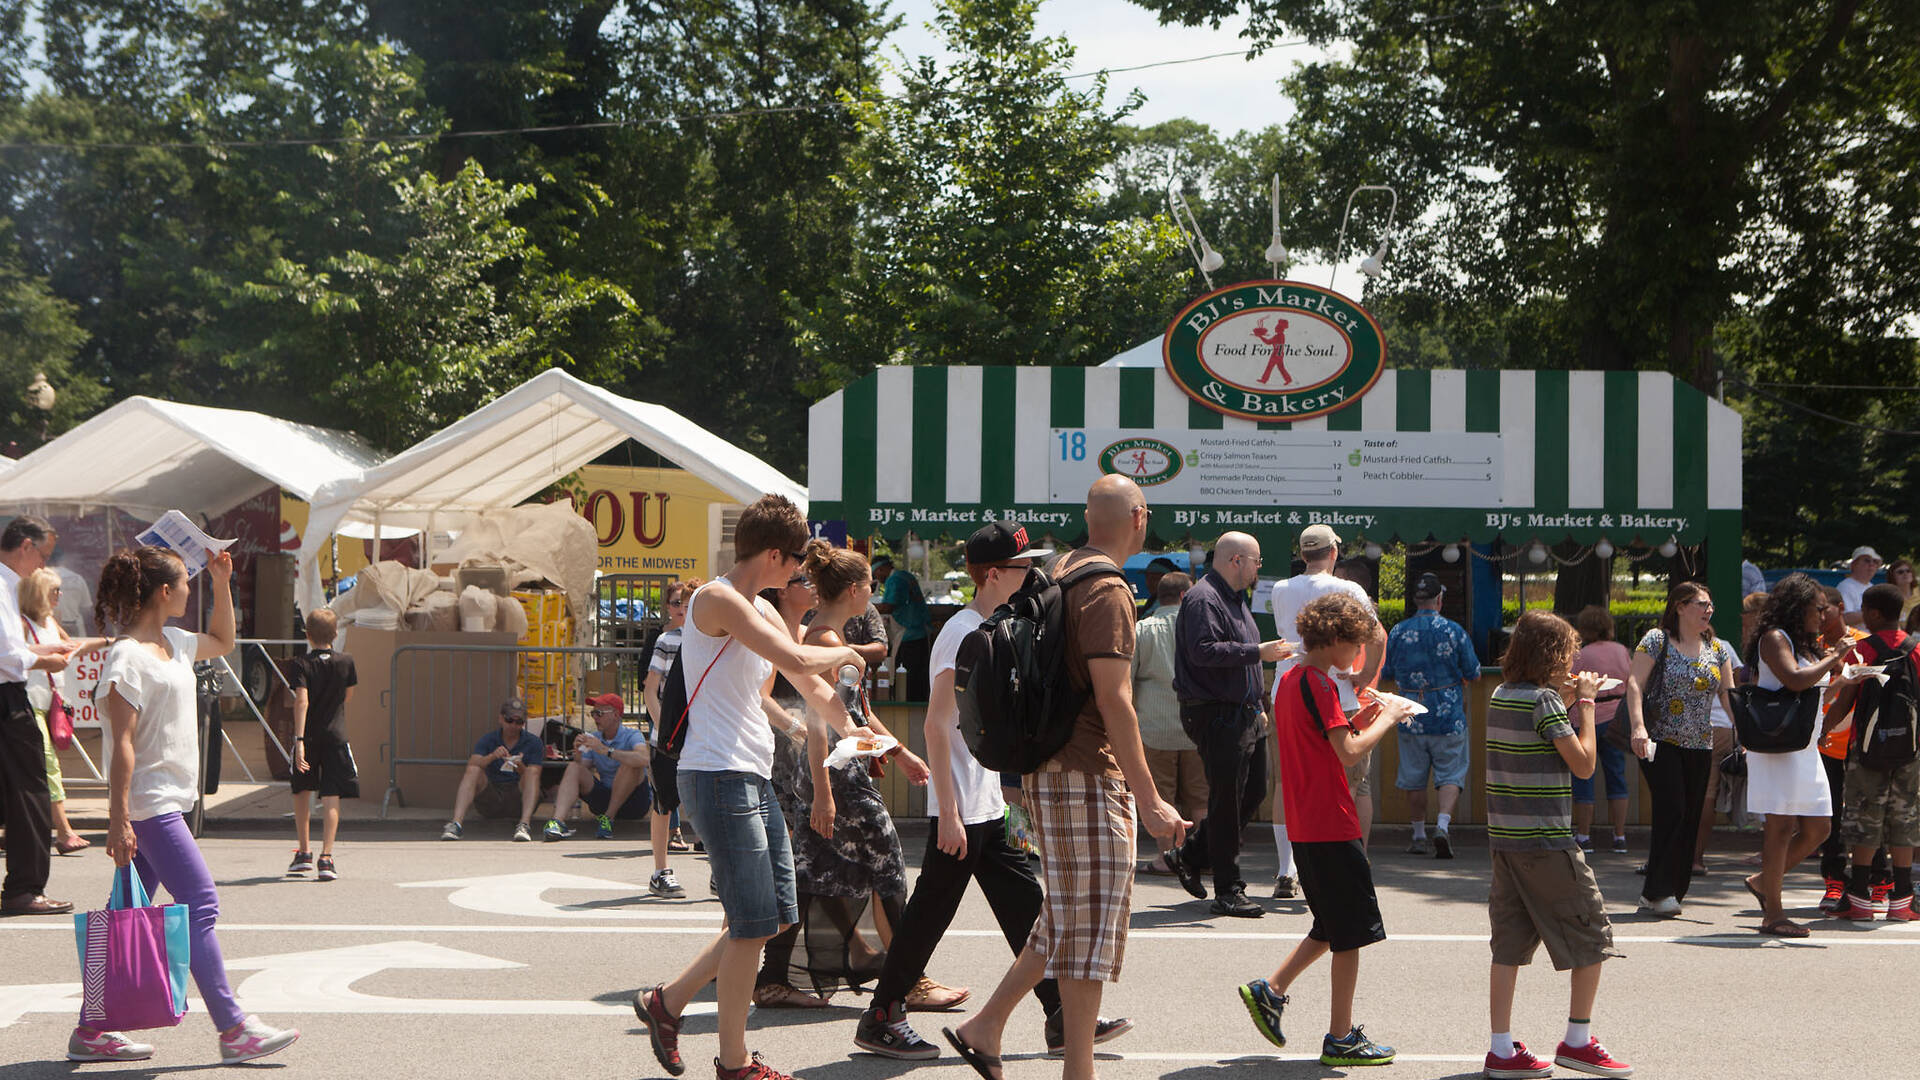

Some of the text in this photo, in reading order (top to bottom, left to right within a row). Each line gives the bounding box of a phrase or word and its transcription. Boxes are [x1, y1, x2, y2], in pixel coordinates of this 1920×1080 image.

[1185, 287, 1359, 335] BJ's Market
[1214, 343, 1247, 356] Food
[1251, 343, 1274, 356] For
[1275, 343, 1302, 356] The
[1202, 381, 1347, 413] & Bakery
[1058, 431, 1086, 462] 18
[1134, 440, 1172, 456] Market
[1200, 438, 1250, 447] Mustard-Fried
[1251, 438, 1276, 447] Catfish
[1364, 440, 1398, 449] Taste of:
[1200, 452, 1221, 461] Crispy
[1224, 452, 1251, 460] Salmon
[1363, 455, 1421, 464] Mustard-Fried
[1423, 456, 1452, 464] Catfish
[1200, 474, 1241, 482] Homemade
[1242, 474, 1265, 482] Potato
[1363, 472, 1388, 480] Peach
[1390, 472, 1424, 481] Cobbler
[1200, 487, 1215, 496] BBQ
[1216, 487, 1244, 495] Chicken
[1244, 488, 1272, 496] Tenders
[868, 508, 905, 525] BJ's
[910, 508, 976, 523] Market
[982, 509, 997, 523] &
[1174, 510, 1210, 527] BJ's
[1216, 510, 1282, 525] Market
[1287, 511, 1302, 525] &
[1485, 512, 1522, 530] BJ's
[1527, 513, 1594, 528] Market
[1599, 514, 1614, 528] &
[615, 556, 638, 568] THE
[642, 557, 696, 569] MIDWEST
